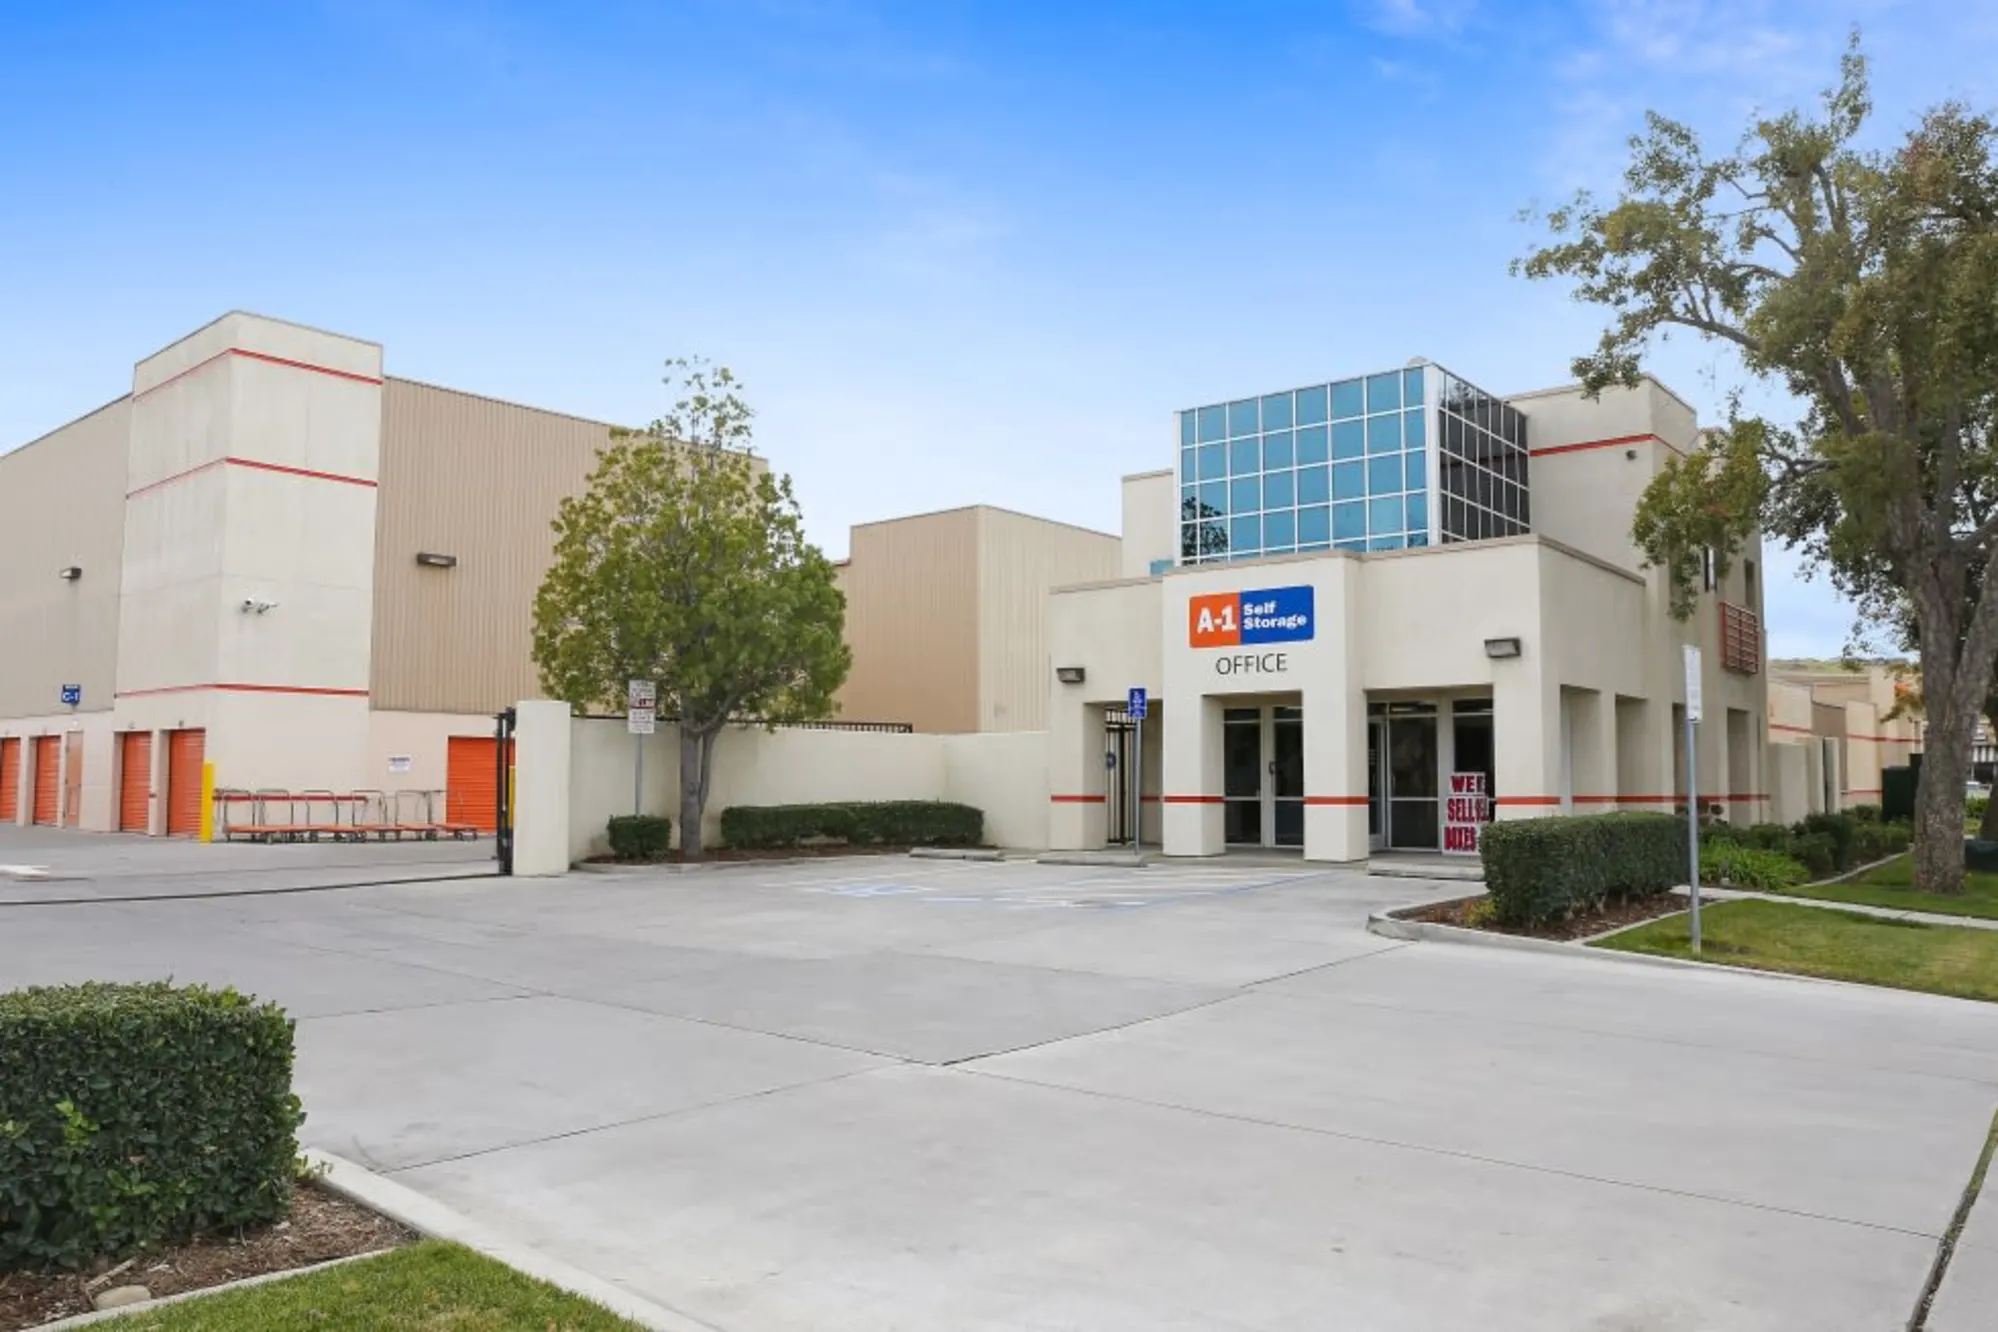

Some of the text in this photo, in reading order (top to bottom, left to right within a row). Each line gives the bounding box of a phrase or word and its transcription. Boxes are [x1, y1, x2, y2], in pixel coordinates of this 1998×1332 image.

[1197, 605, 1237, 633] A-1
[1243, 601, 1276, 615] Self
[1243, 615, 1307, 630] Storage
[1215, 653, 1288, 675] OFFICE
[1447, 798, 1475, 822] SELL
